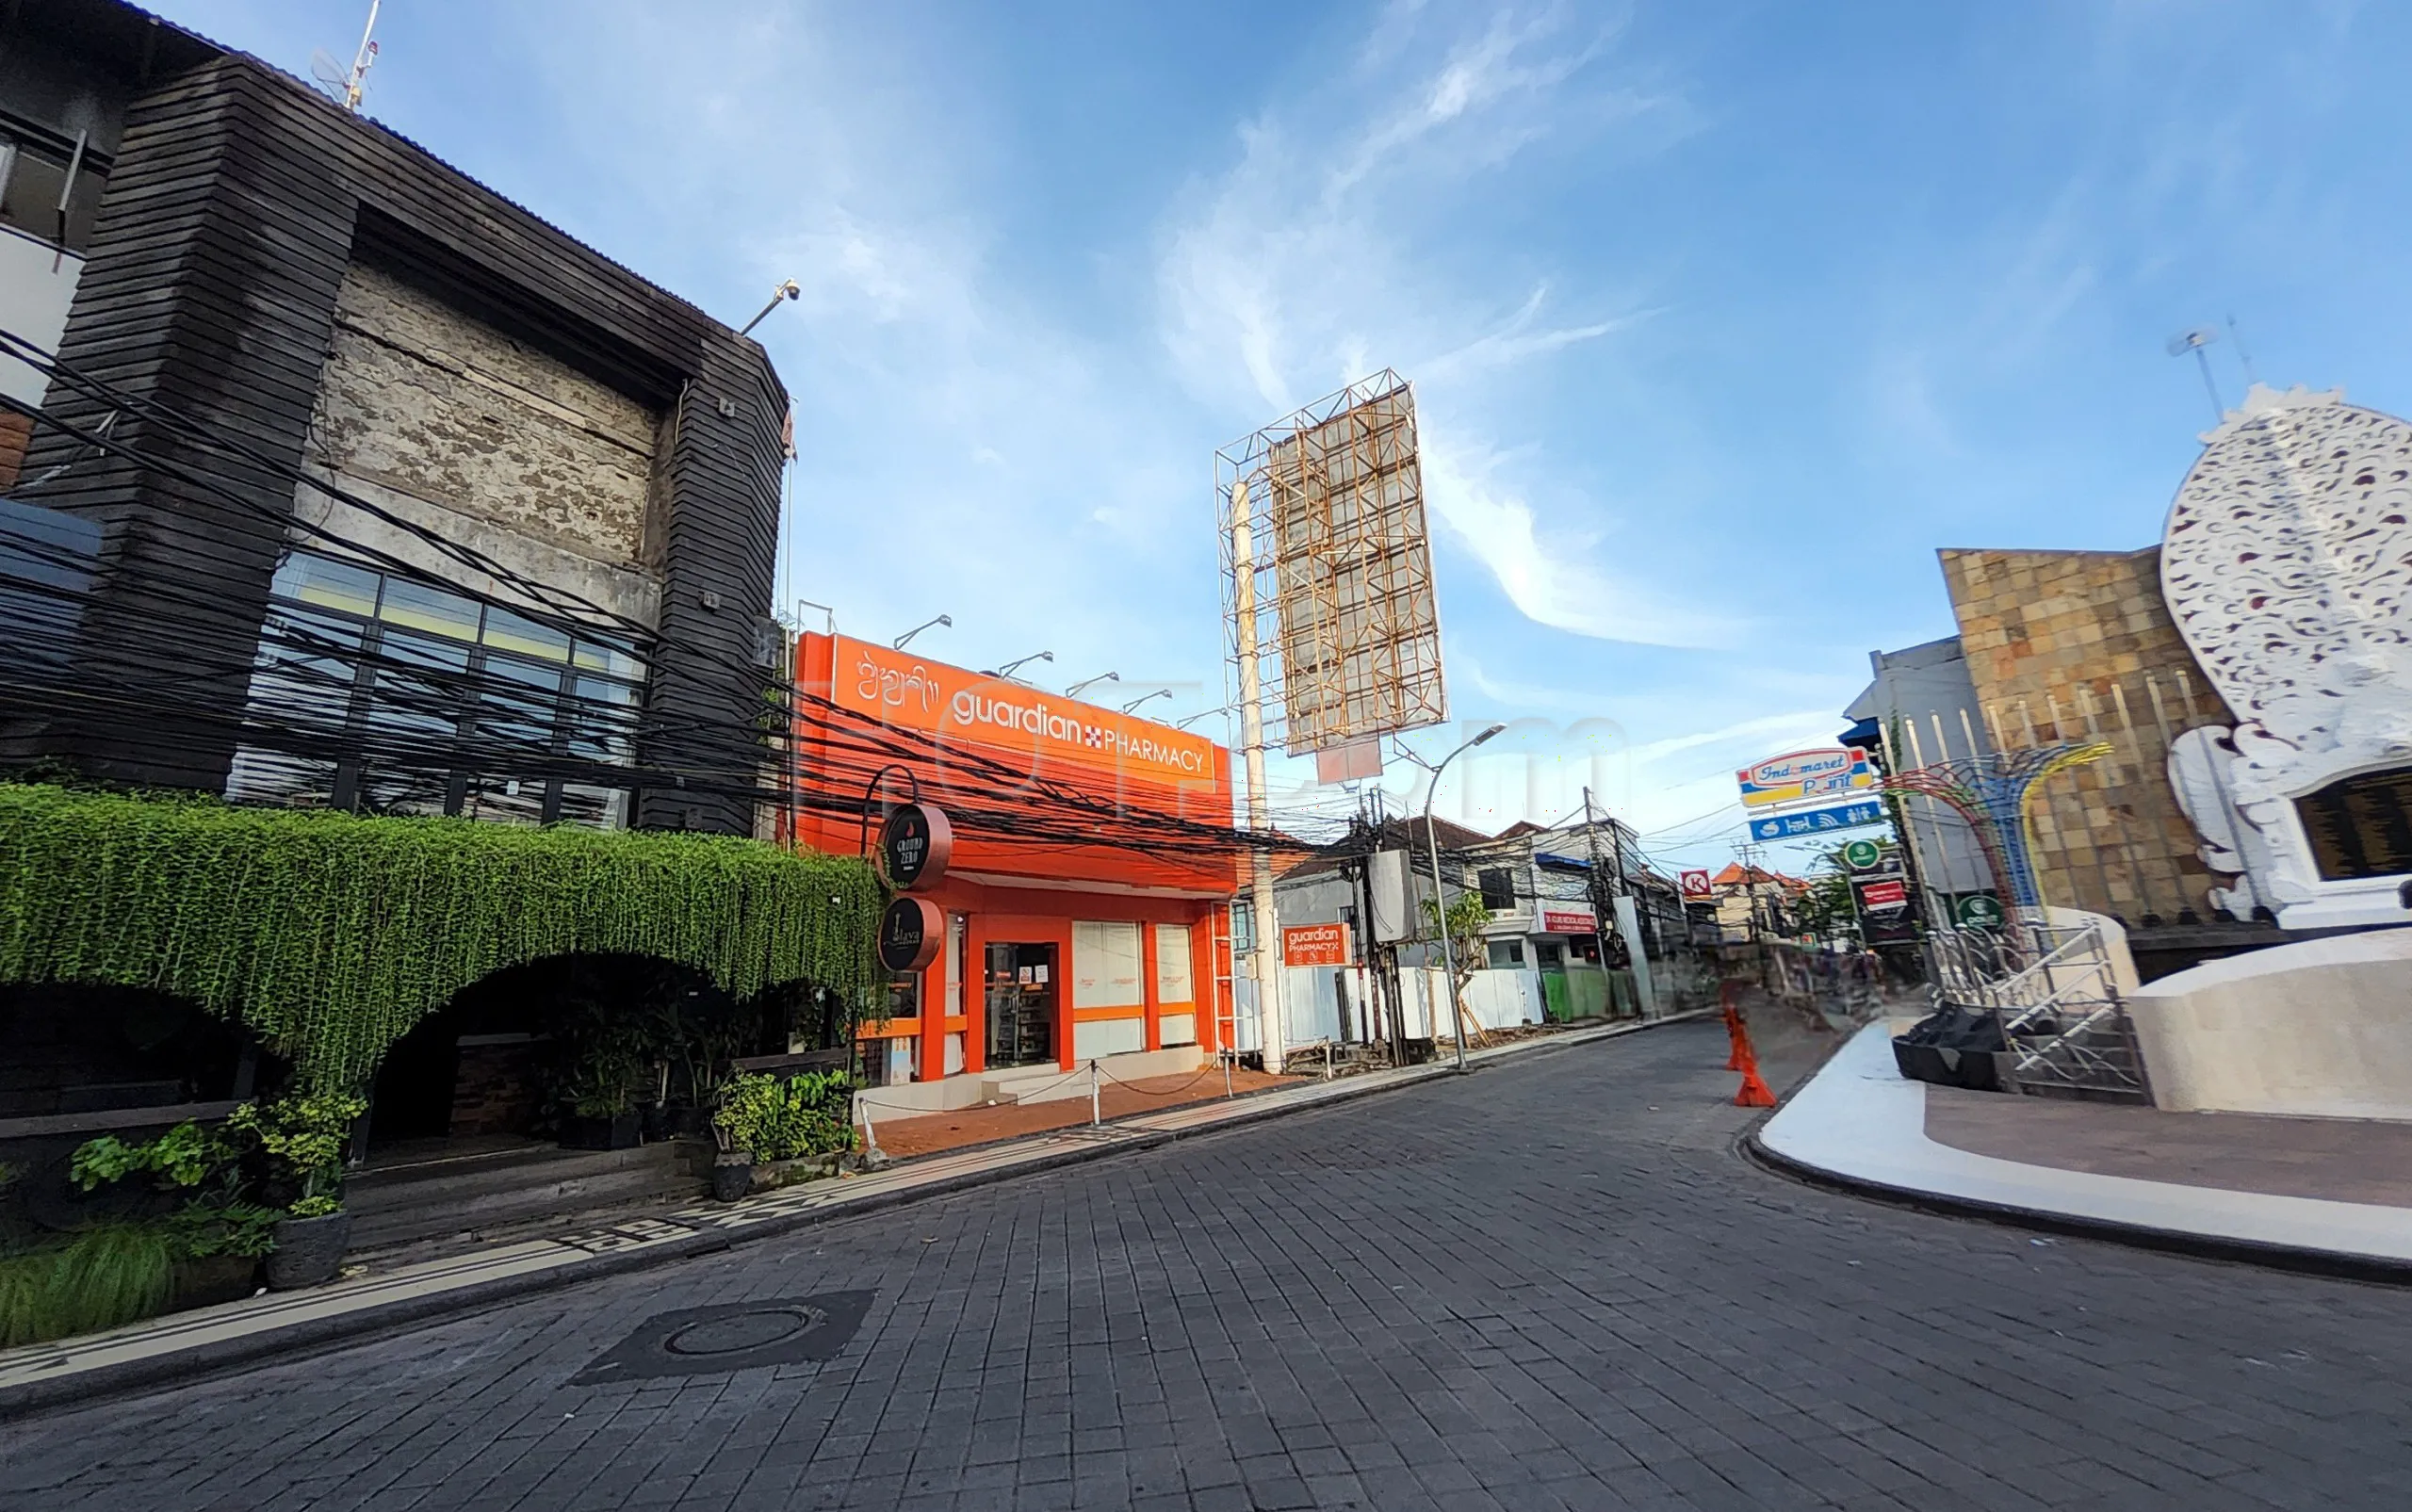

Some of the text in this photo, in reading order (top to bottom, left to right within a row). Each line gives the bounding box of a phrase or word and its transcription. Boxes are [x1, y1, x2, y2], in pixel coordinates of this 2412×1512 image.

[952, 690, 1204, 773] guardian PHARMACY
[1759, 755, 1844, 781] Indomaret
[896, 837, 923, 853] GROUND
[901, 851, 919, 865] ZERO
[1288, 927, 1339, 945] guardian
[1288, 942, 1331, 952] PHARMACY
